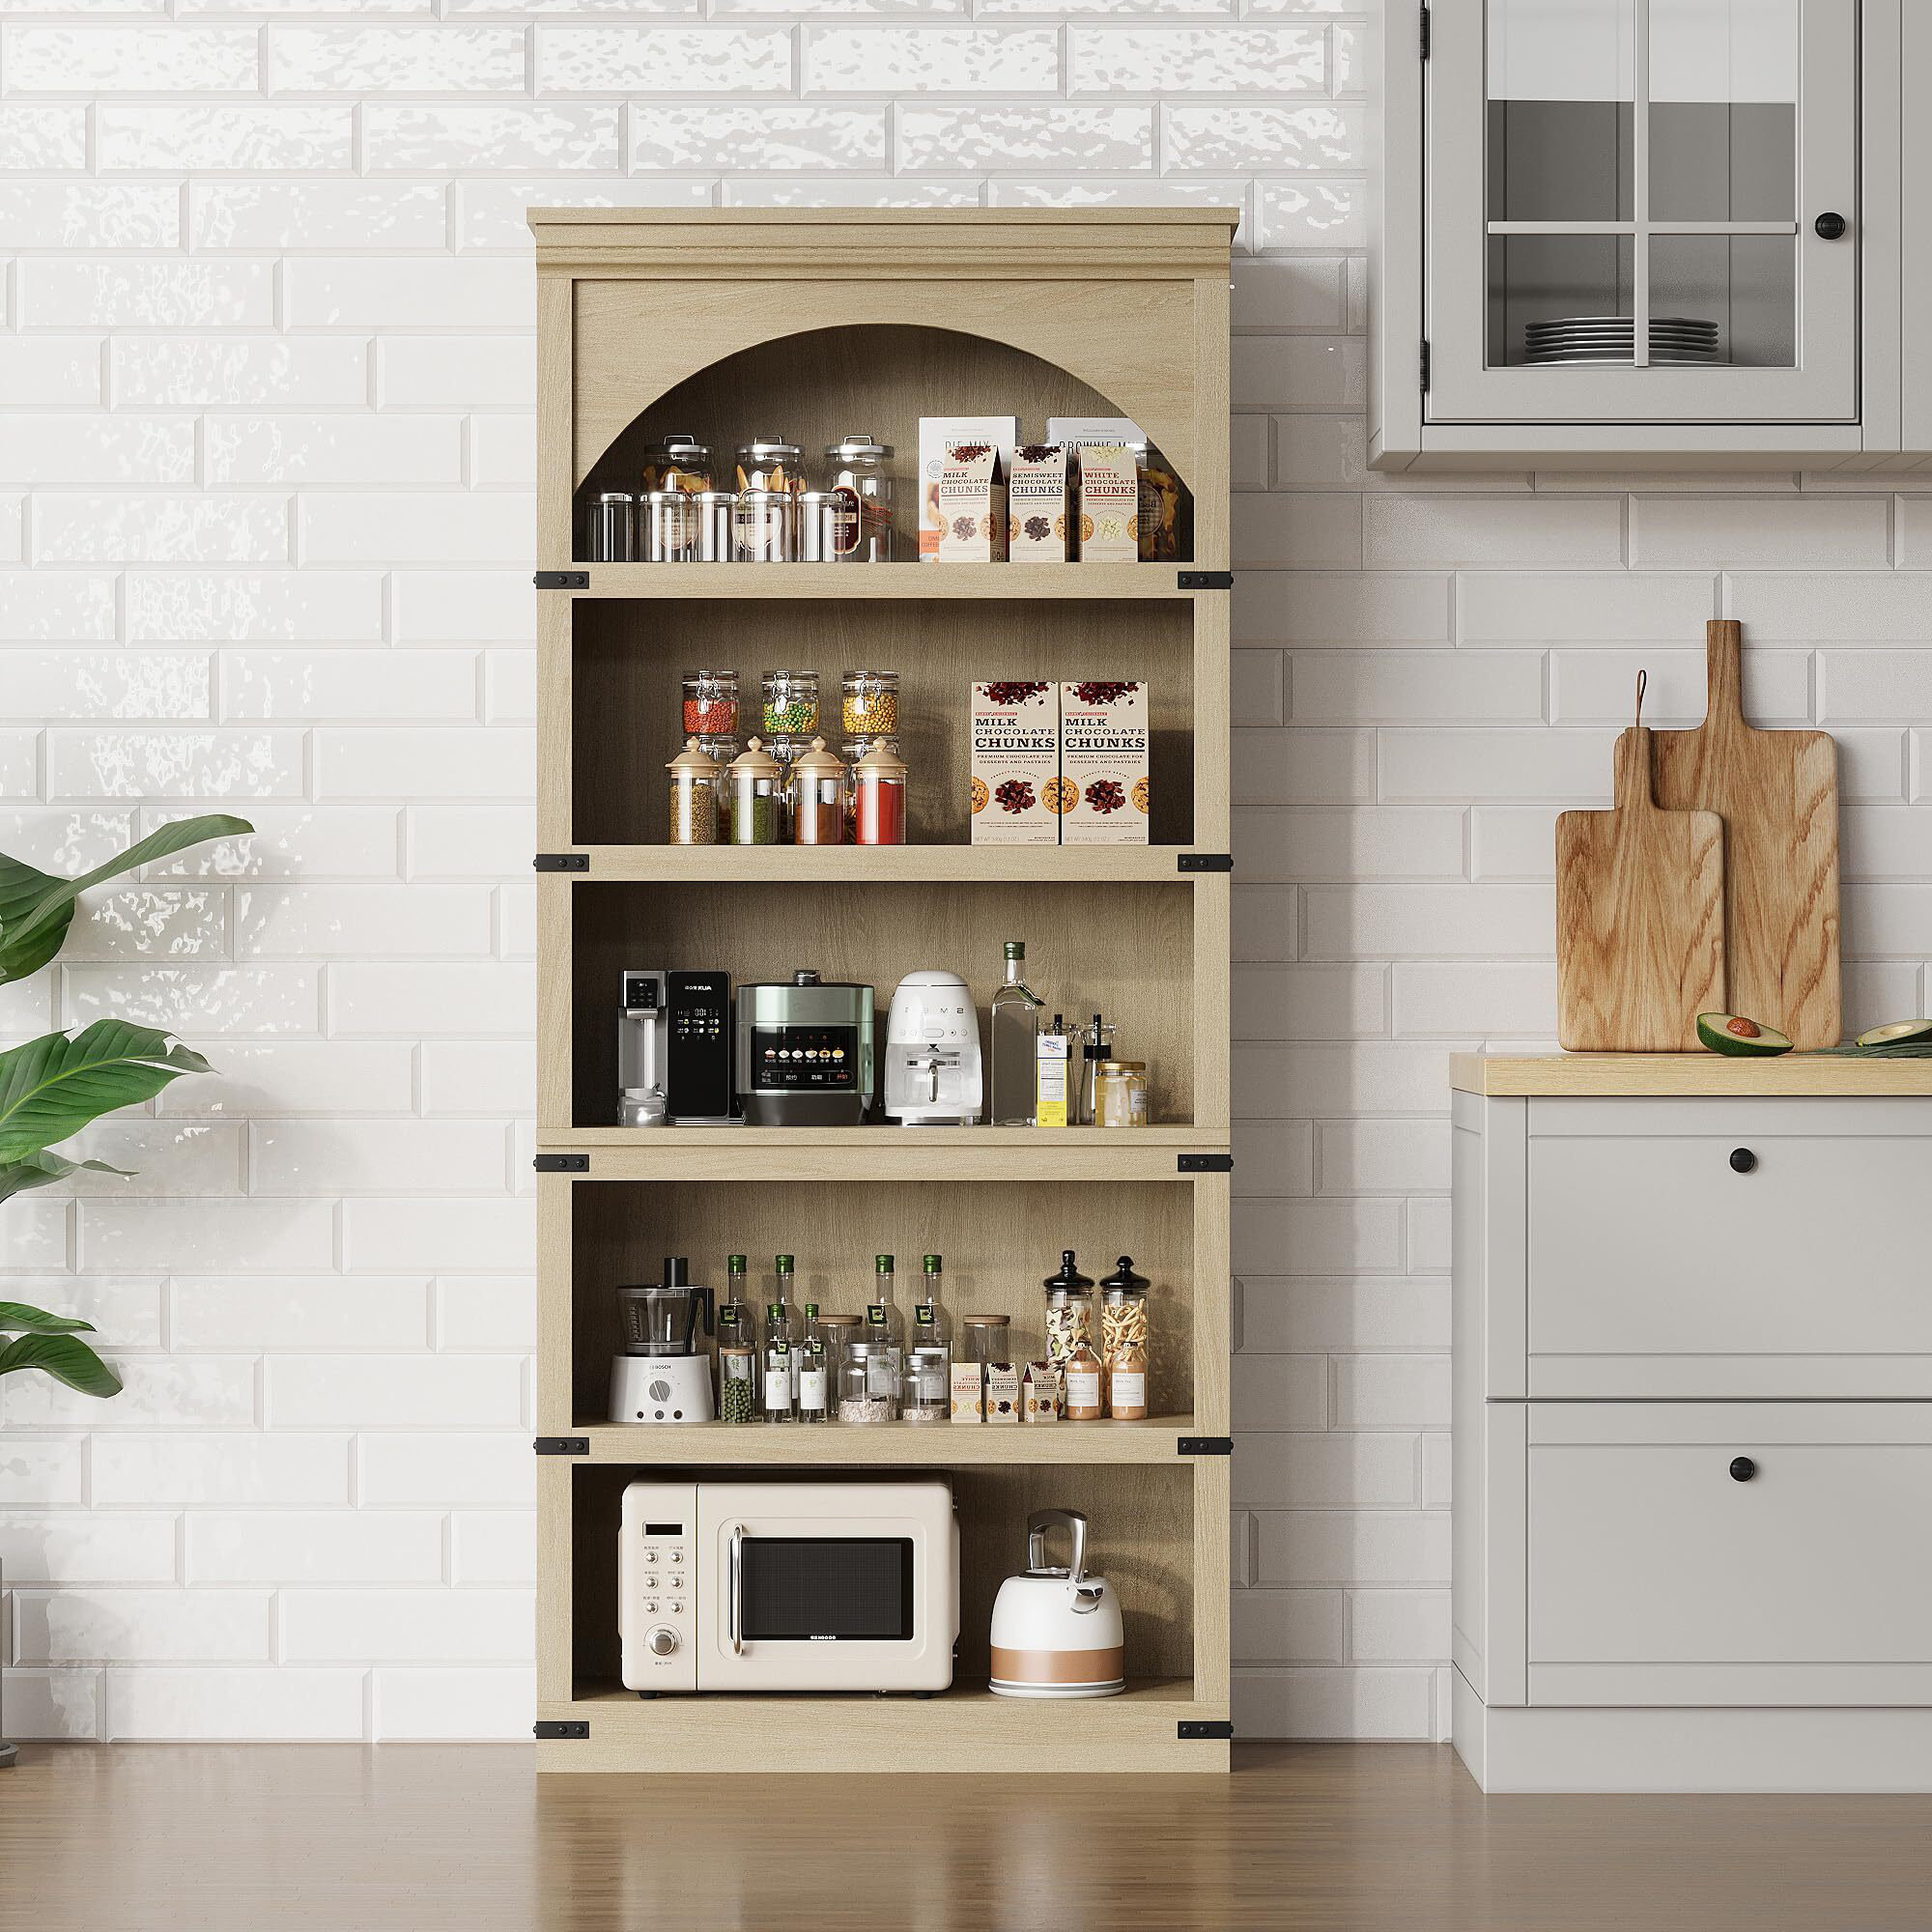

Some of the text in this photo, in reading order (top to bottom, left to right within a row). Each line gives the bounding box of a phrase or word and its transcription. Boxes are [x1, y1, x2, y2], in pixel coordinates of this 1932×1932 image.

[941, 485, 988, 494] CHUNKS
[976, 718, 1017, 726] MILK
[1065, 718, 1107, 726] MILK
[976, 738, 1055, 748] CHUNKS
[1065, 738, 1145, 748] CHUNKS
